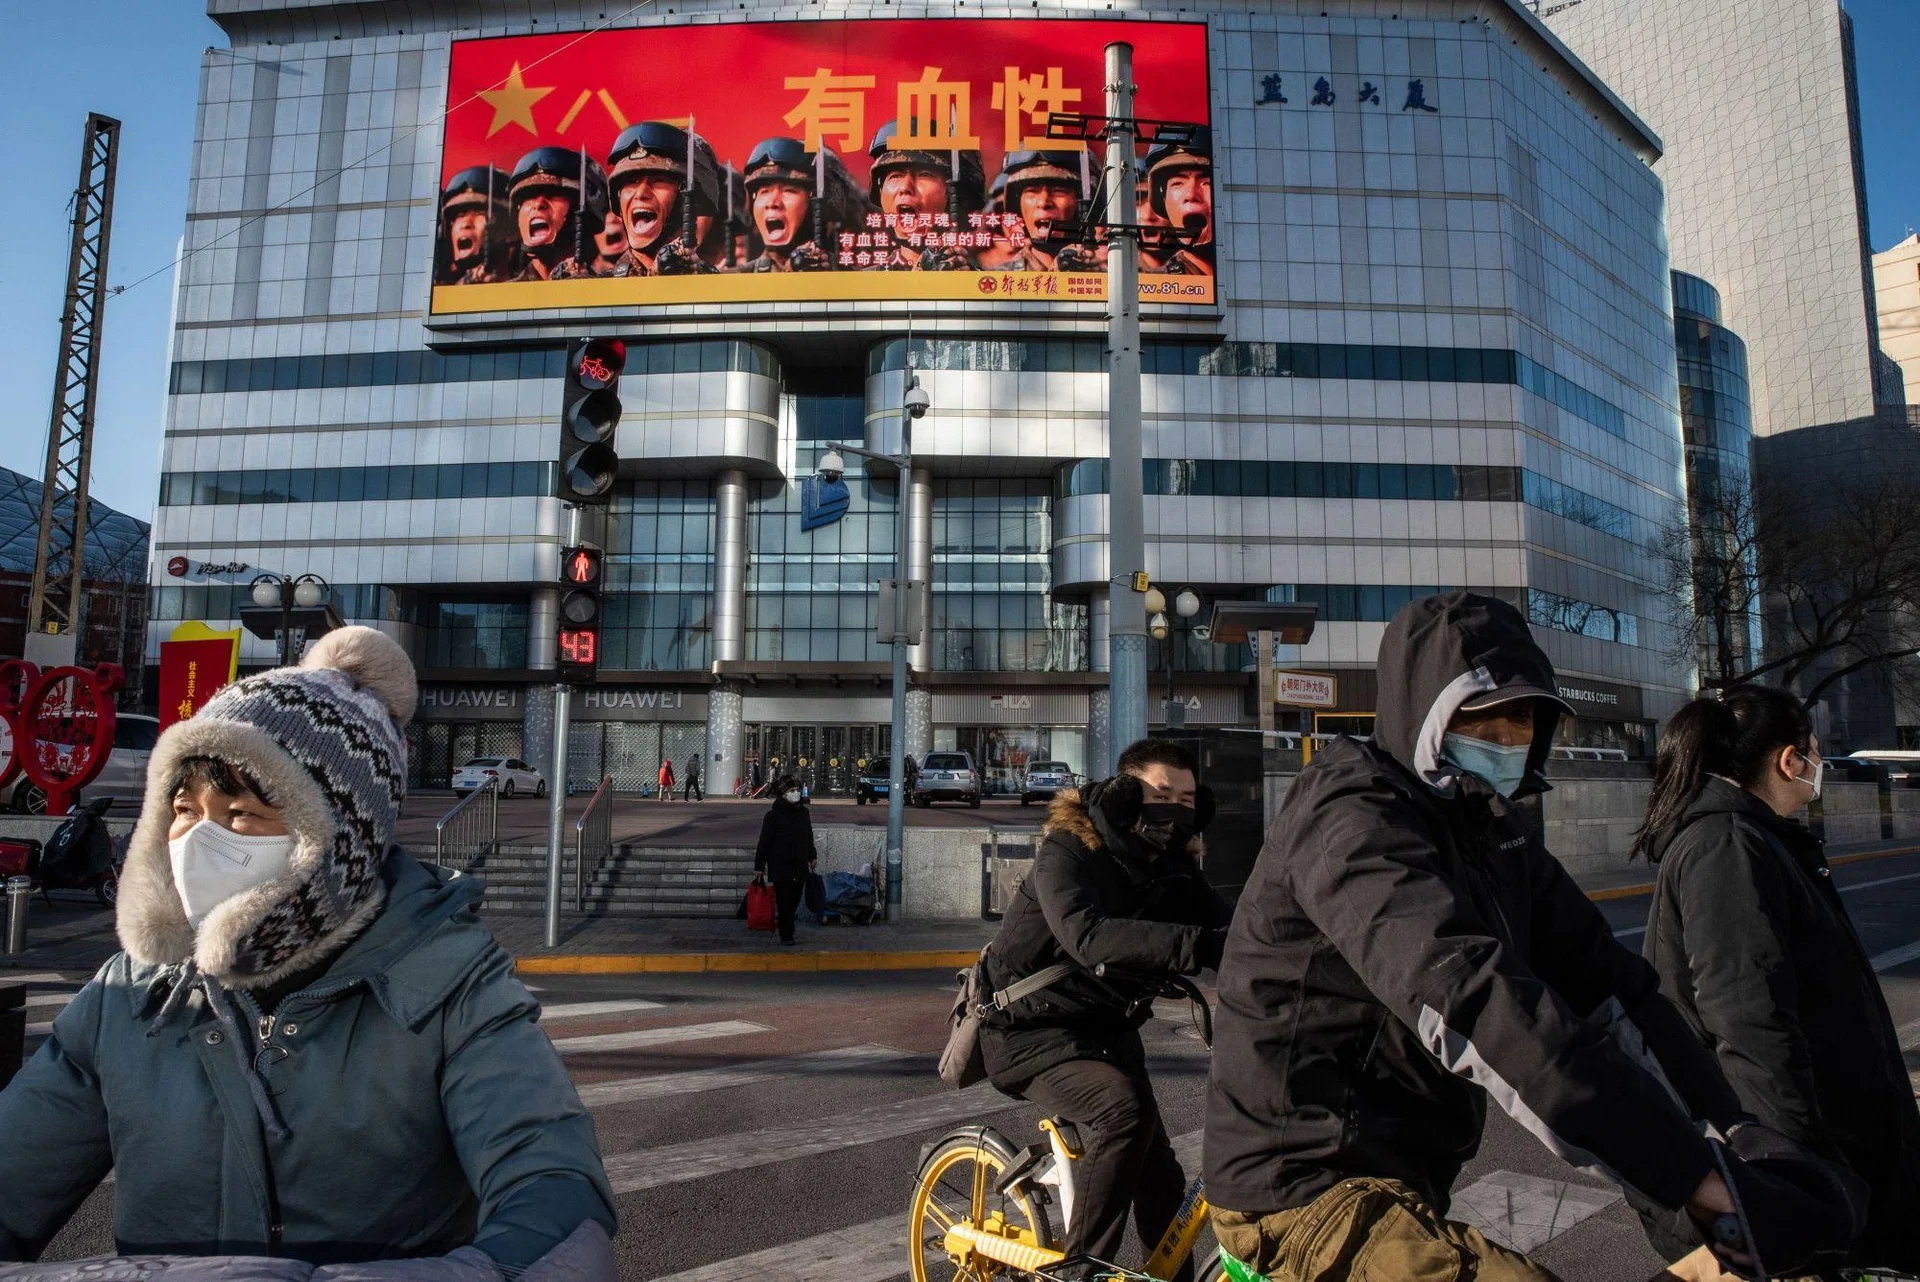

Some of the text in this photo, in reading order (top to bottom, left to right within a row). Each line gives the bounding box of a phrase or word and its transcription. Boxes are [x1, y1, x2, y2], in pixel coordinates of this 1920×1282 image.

[782, 66, 1087, 153] 有血性
[839, 232, 1025, 247] 有血性、有品德的新一代
[839, 251, 914, 266] 革命军人。
[562, 631, 594, 662] 43
[187, 661, 197, 698] 社会主义
[422, 688, 517, 708] HUAWEI
[584, 690, 682, 709] HUAWEI
[990, 695, 1031, 709] FILA
[1558, 686, 1617, 704] STARBUCKS COFFEE
